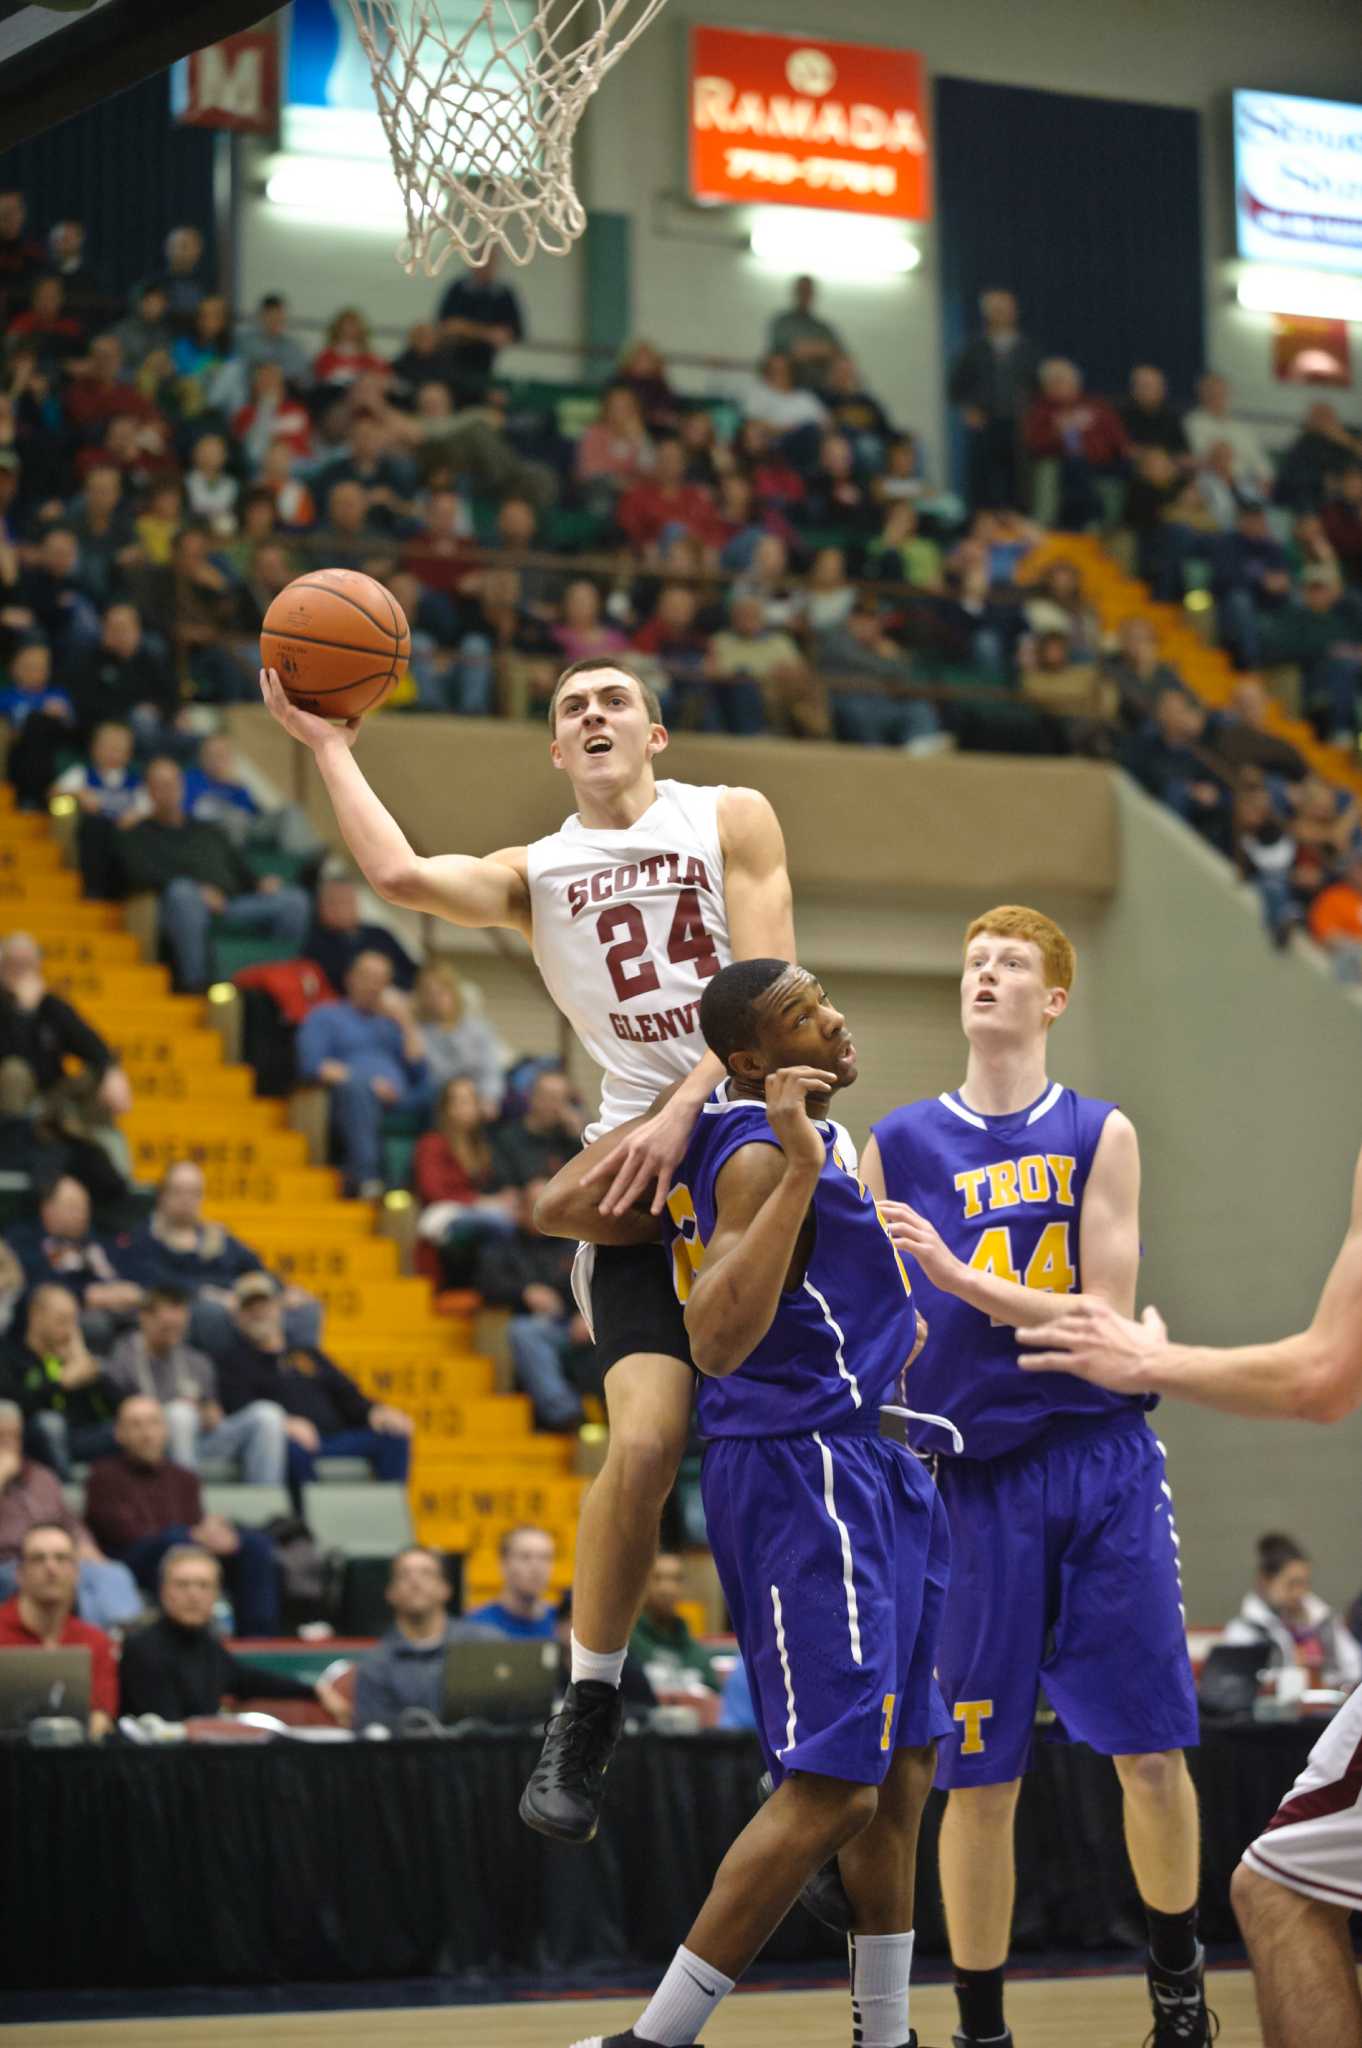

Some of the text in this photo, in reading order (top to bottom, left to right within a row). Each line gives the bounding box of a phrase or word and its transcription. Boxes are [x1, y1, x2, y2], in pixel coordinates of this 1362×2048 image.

[693, 76, 925, 155] RAMADA
[568, 853, 713, 918] SCOTIA
[596, 887, 722, 1003] 24
[609, 999, 702, 1043] GLENV
[954, 1154, 1077, 1219] TROY
[966, 1221, 1076, 1297] 44
[953, 1699, 993, 1755] T
